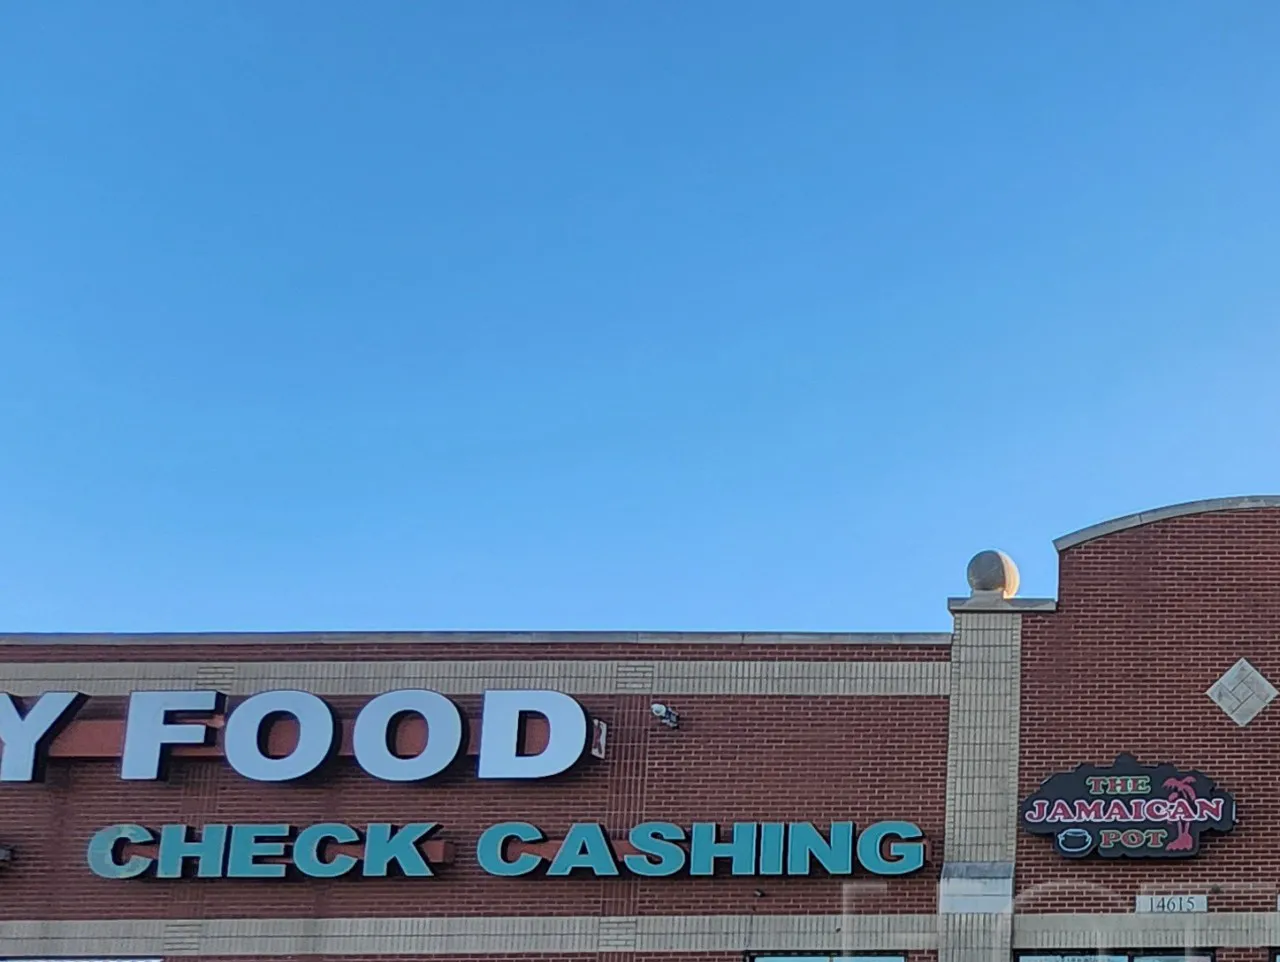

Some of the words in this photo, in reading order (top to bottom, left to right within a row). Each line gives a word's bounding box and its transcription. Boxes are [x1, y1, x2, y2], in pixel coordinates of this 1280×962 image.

[120, 689, 588, 781] FOOD
[1086, 776, 1151, 795] THE
[1025, 798, 1225, 822] JAMAICAN
[1100, 829, 1168, 848] POT
[87, 823, 440, 879] CHECK
[477, 821, 925, 877] CASHING
[1149, 895, 1196, 912] 14615
